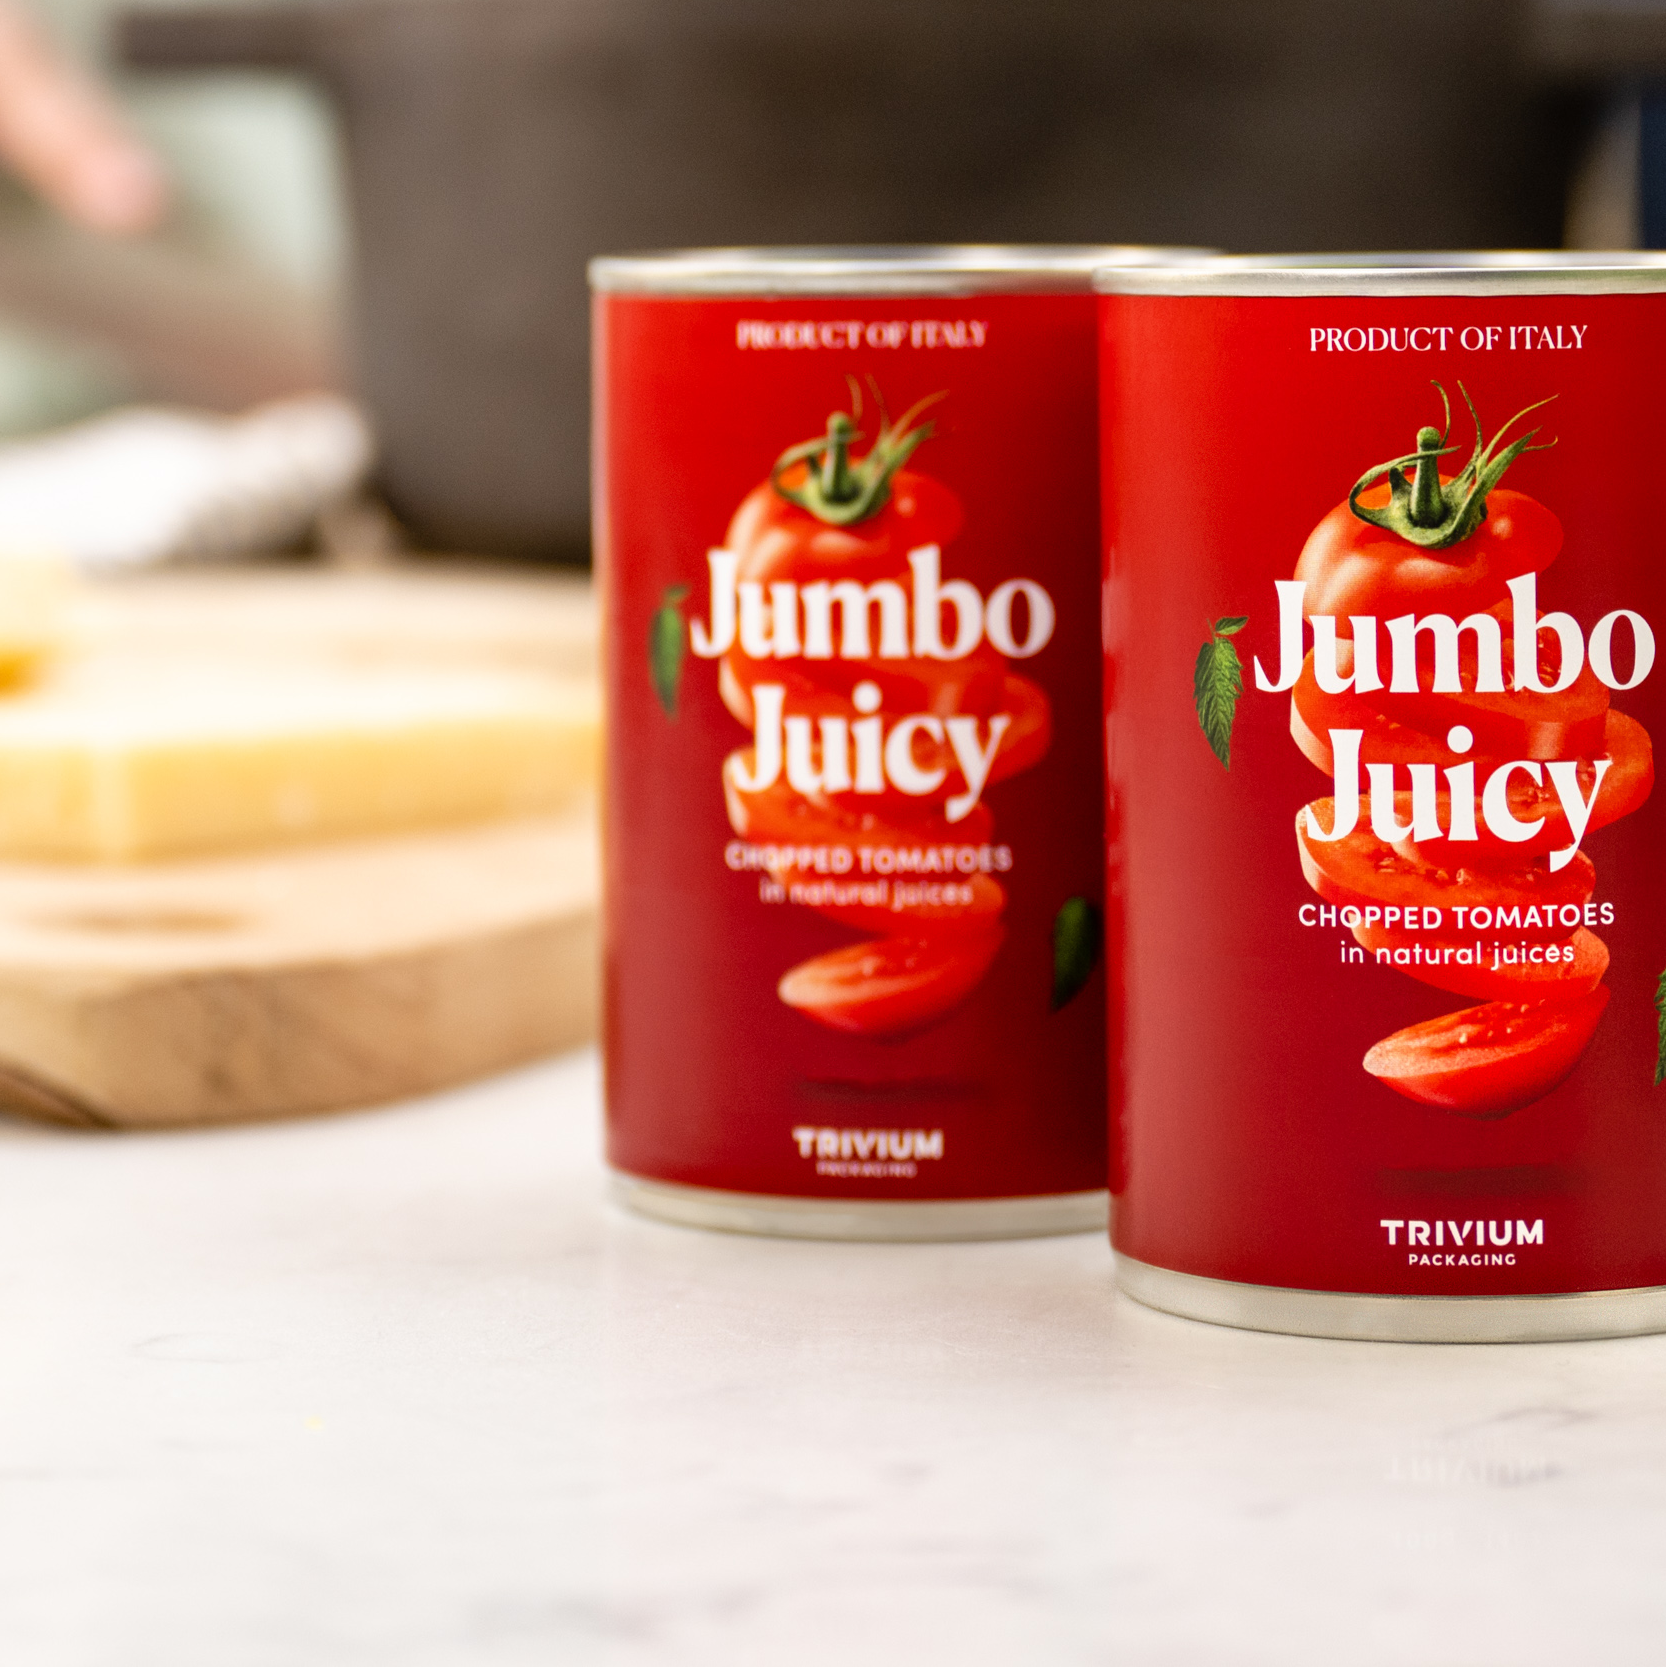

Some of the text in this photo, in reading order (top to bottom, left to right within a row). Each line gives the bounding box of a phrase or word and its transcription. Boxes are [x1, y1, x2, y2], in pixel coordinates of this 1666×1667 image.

[736, 319, 865, 350] PRODUCT
[1310, 324, 1588, 352] PRODUCT OF ITALY
[690, 544, 1056, 661] Jumbo
[1253, 571, 1656, 694] Jumbo
[732, 680, 1012, 824] Juicy
[1304, 725, 1613, 873] Juicy
[725, 842, 1013, 874] CHOPPED TOMATOES
[759, 877, 974, 912] in natural juices
[1298, 902, 1615, 930] CHOPPED TOMATOES
[1340, 940, 1575, 971] in natural juices
[792, 1125, 945, 1160] TRIVIUM
[1380, 1219, 1544, 1246] TRIVIUM
[1408, 1253, 1517, 1266] PACKAGING
